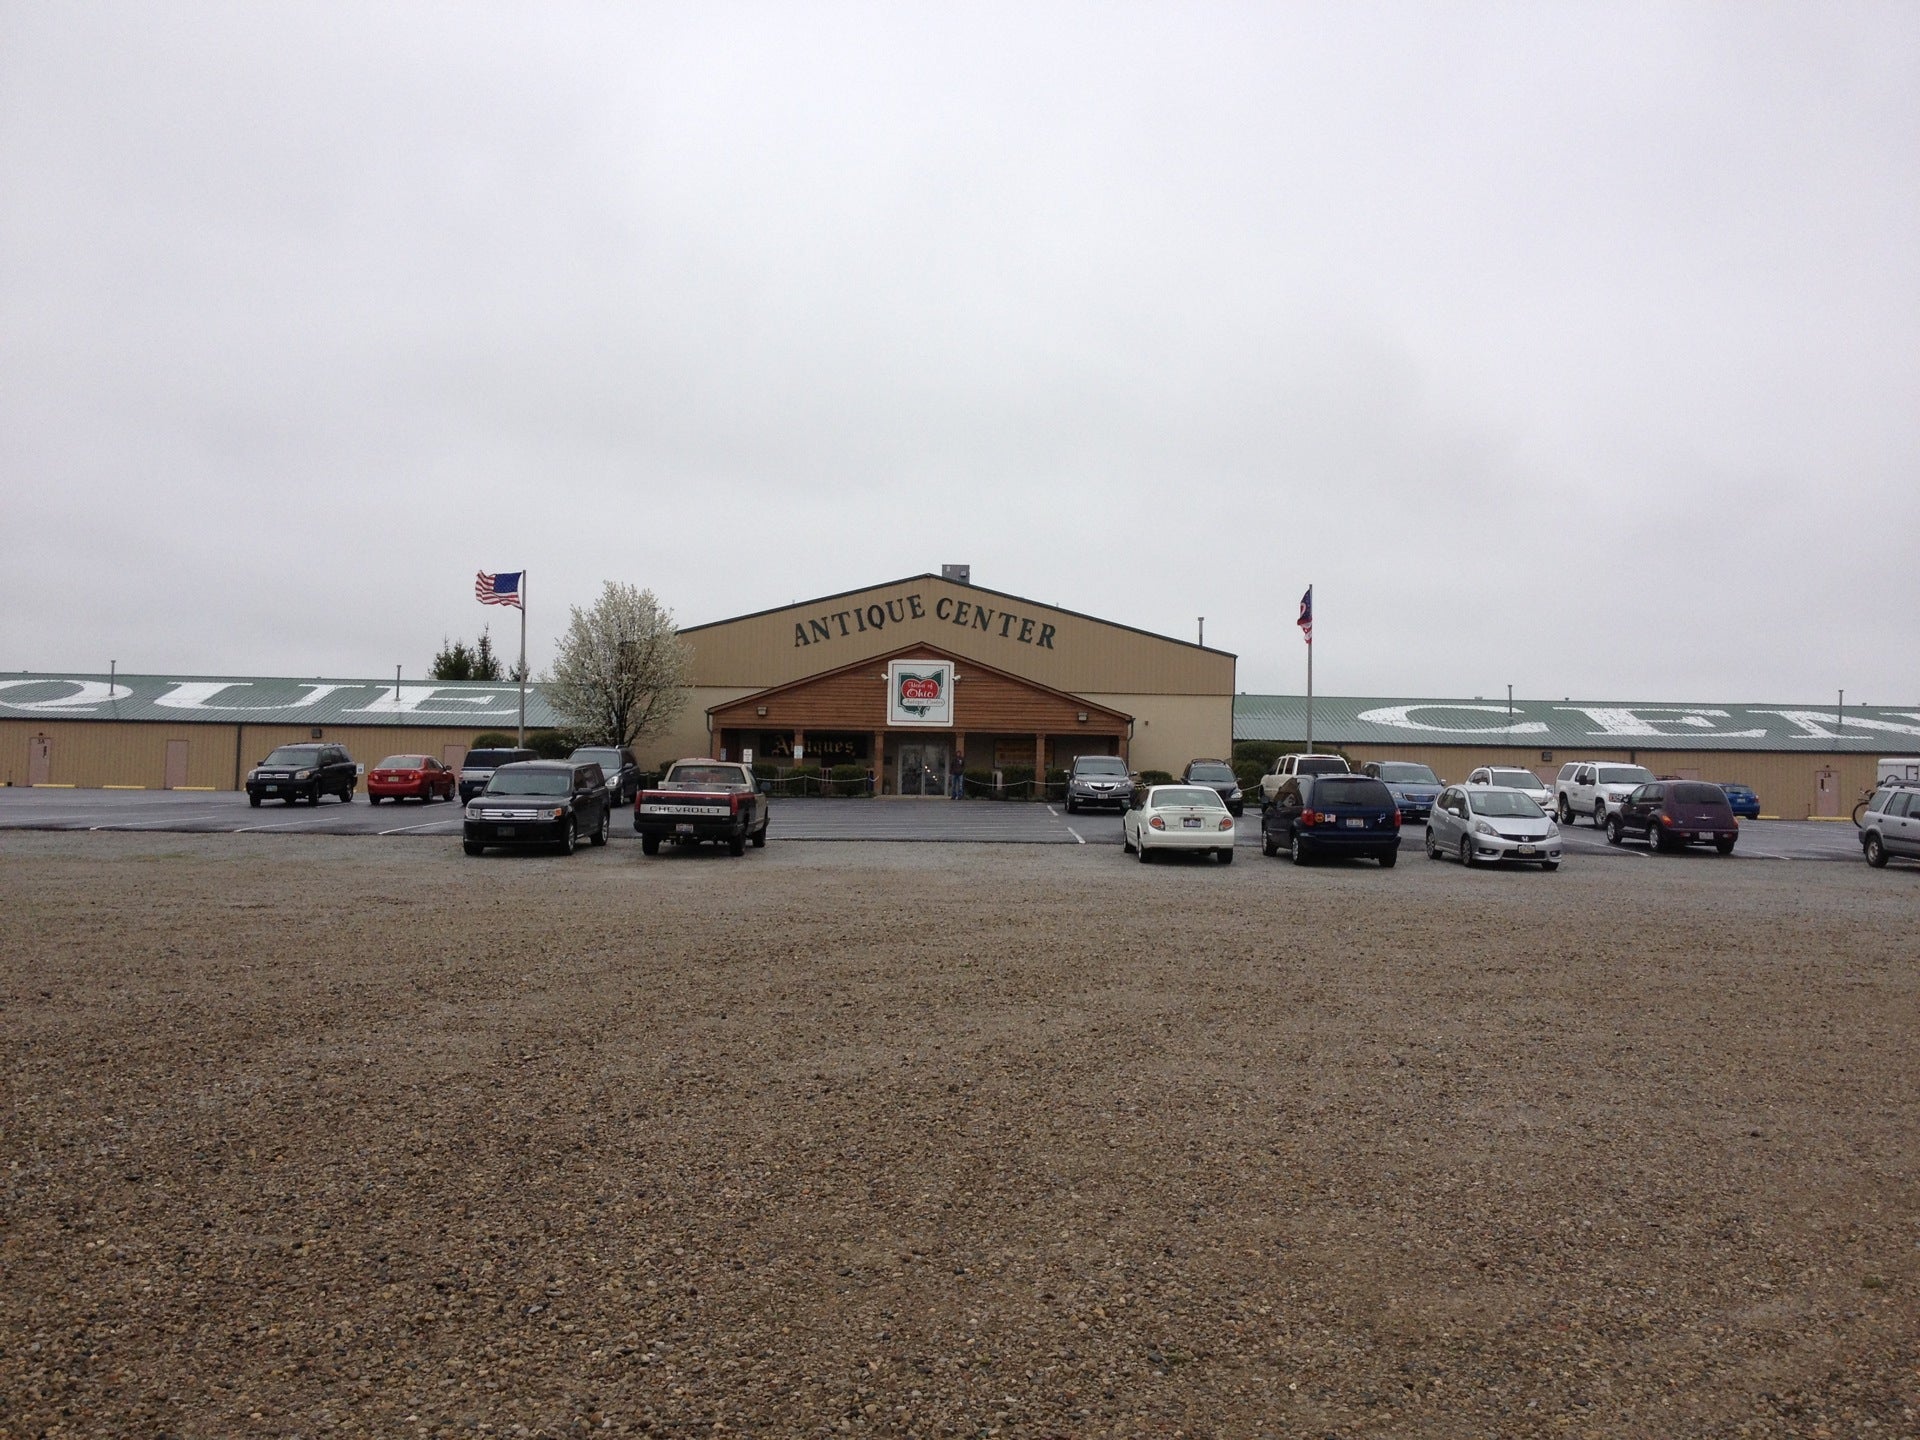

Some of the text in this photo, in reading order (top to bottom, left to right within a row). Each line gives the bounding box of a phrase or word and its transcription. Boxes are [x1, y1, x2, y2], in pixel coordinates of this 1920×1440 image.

[794, 594, 1056, 650] ANTIQUE CENTER
[907, 688, 934, 697] Ohio
[772, 736, 856, 757] Aiques
[649, 805, 721, 814] CHEVROLET
